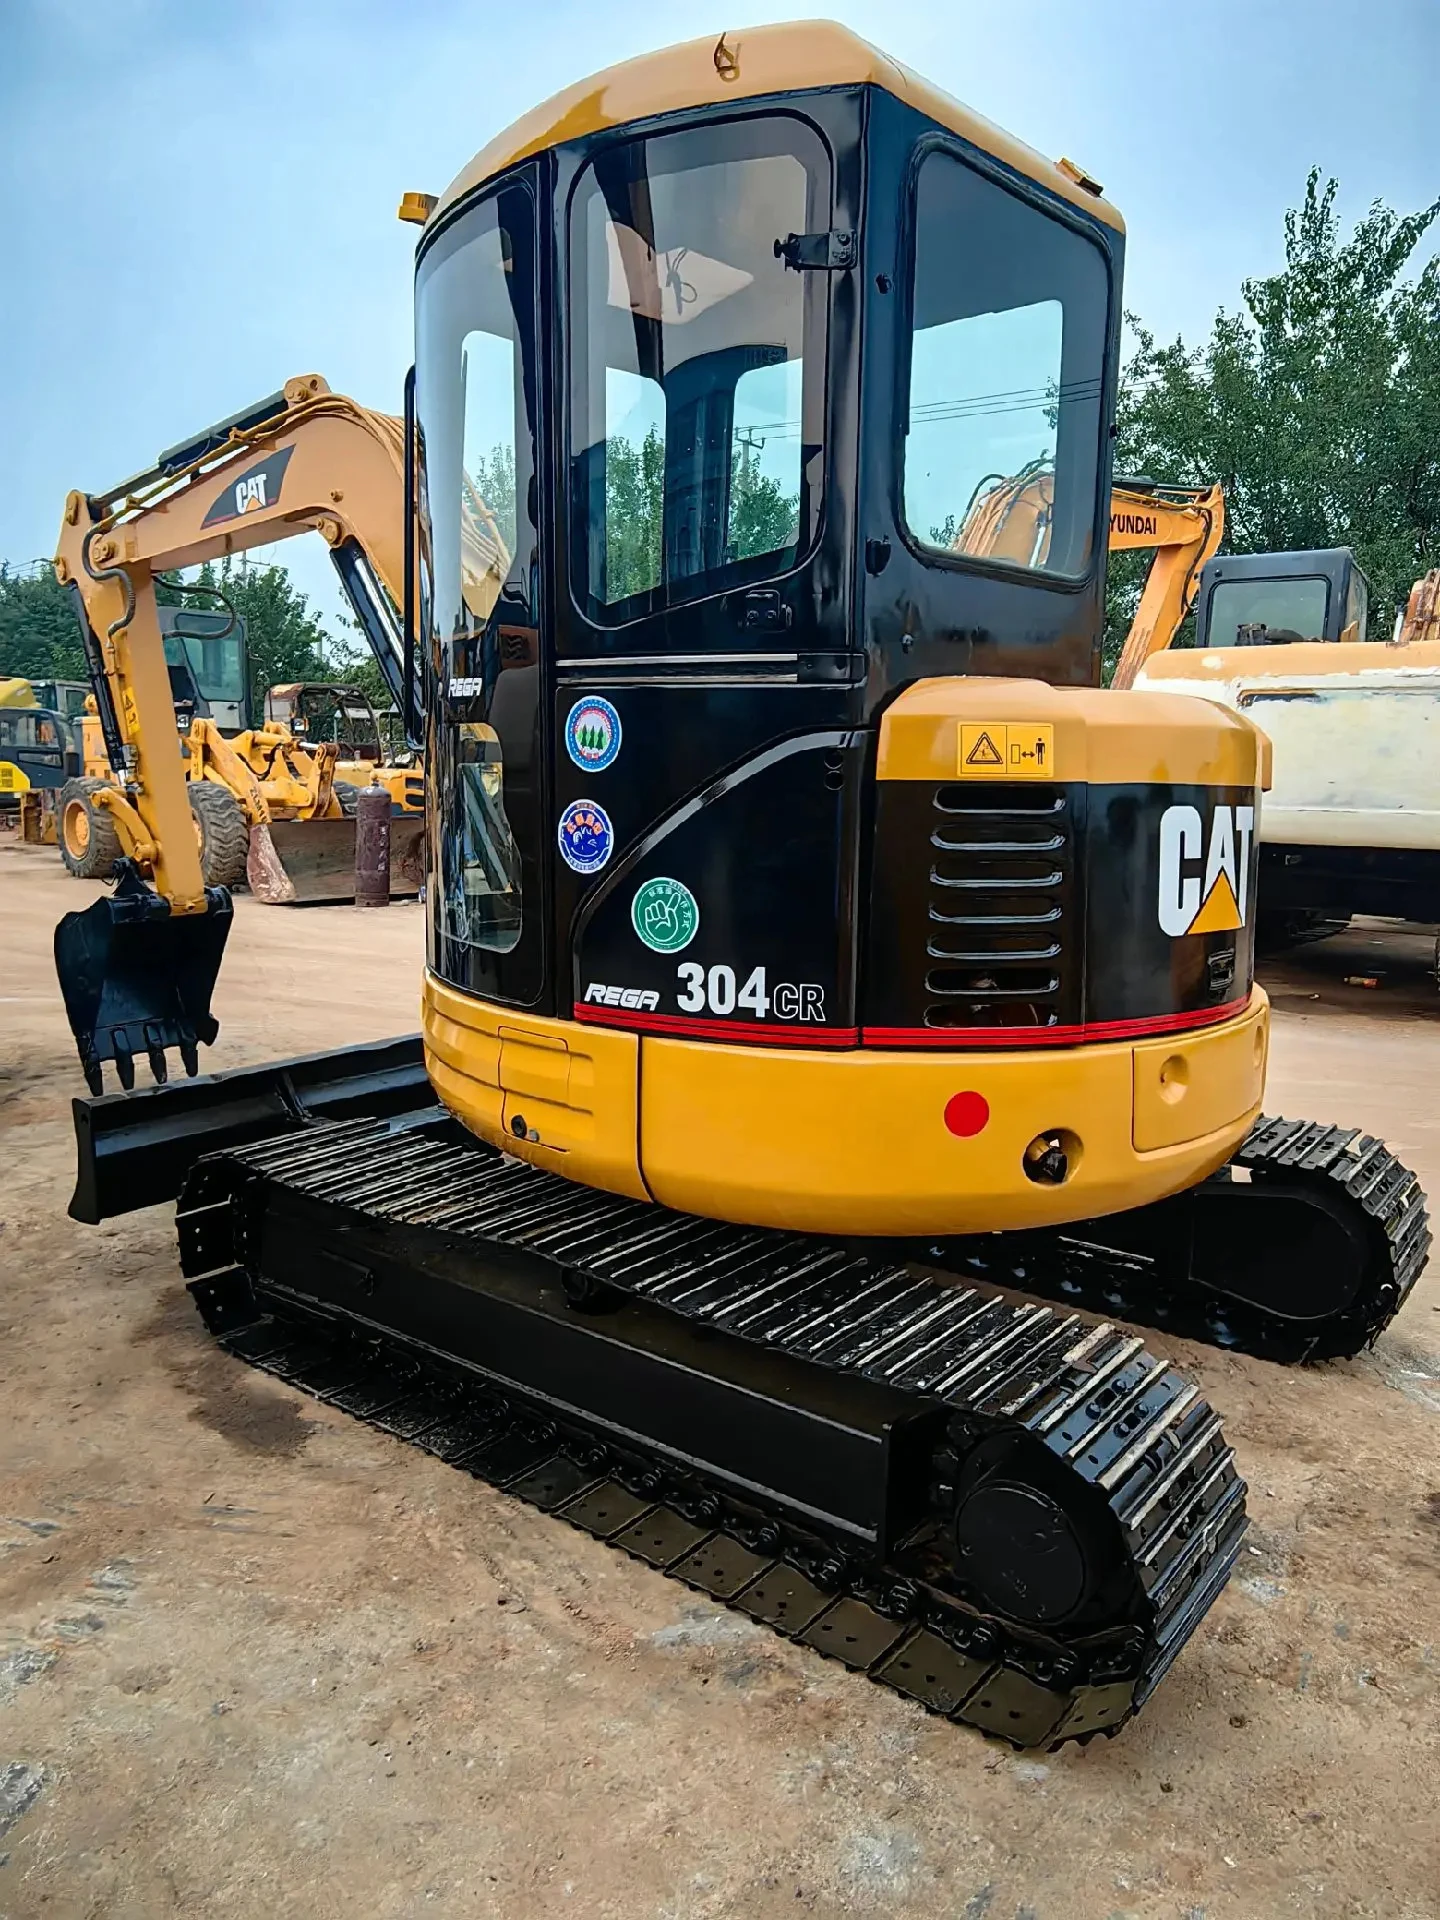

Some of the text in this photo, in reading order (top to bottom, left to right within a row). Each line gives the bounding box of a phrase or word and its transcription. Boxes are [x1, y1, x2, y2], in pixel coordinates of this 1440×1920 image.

[235, 473, 268, 514] CAT
[1109, 513, 1157, 535] YUNDAI
[448, 677, 483, 698] REGA
[1158, 805, 1254, 937] CAT
[584, 982, 660, 1011] REGA
